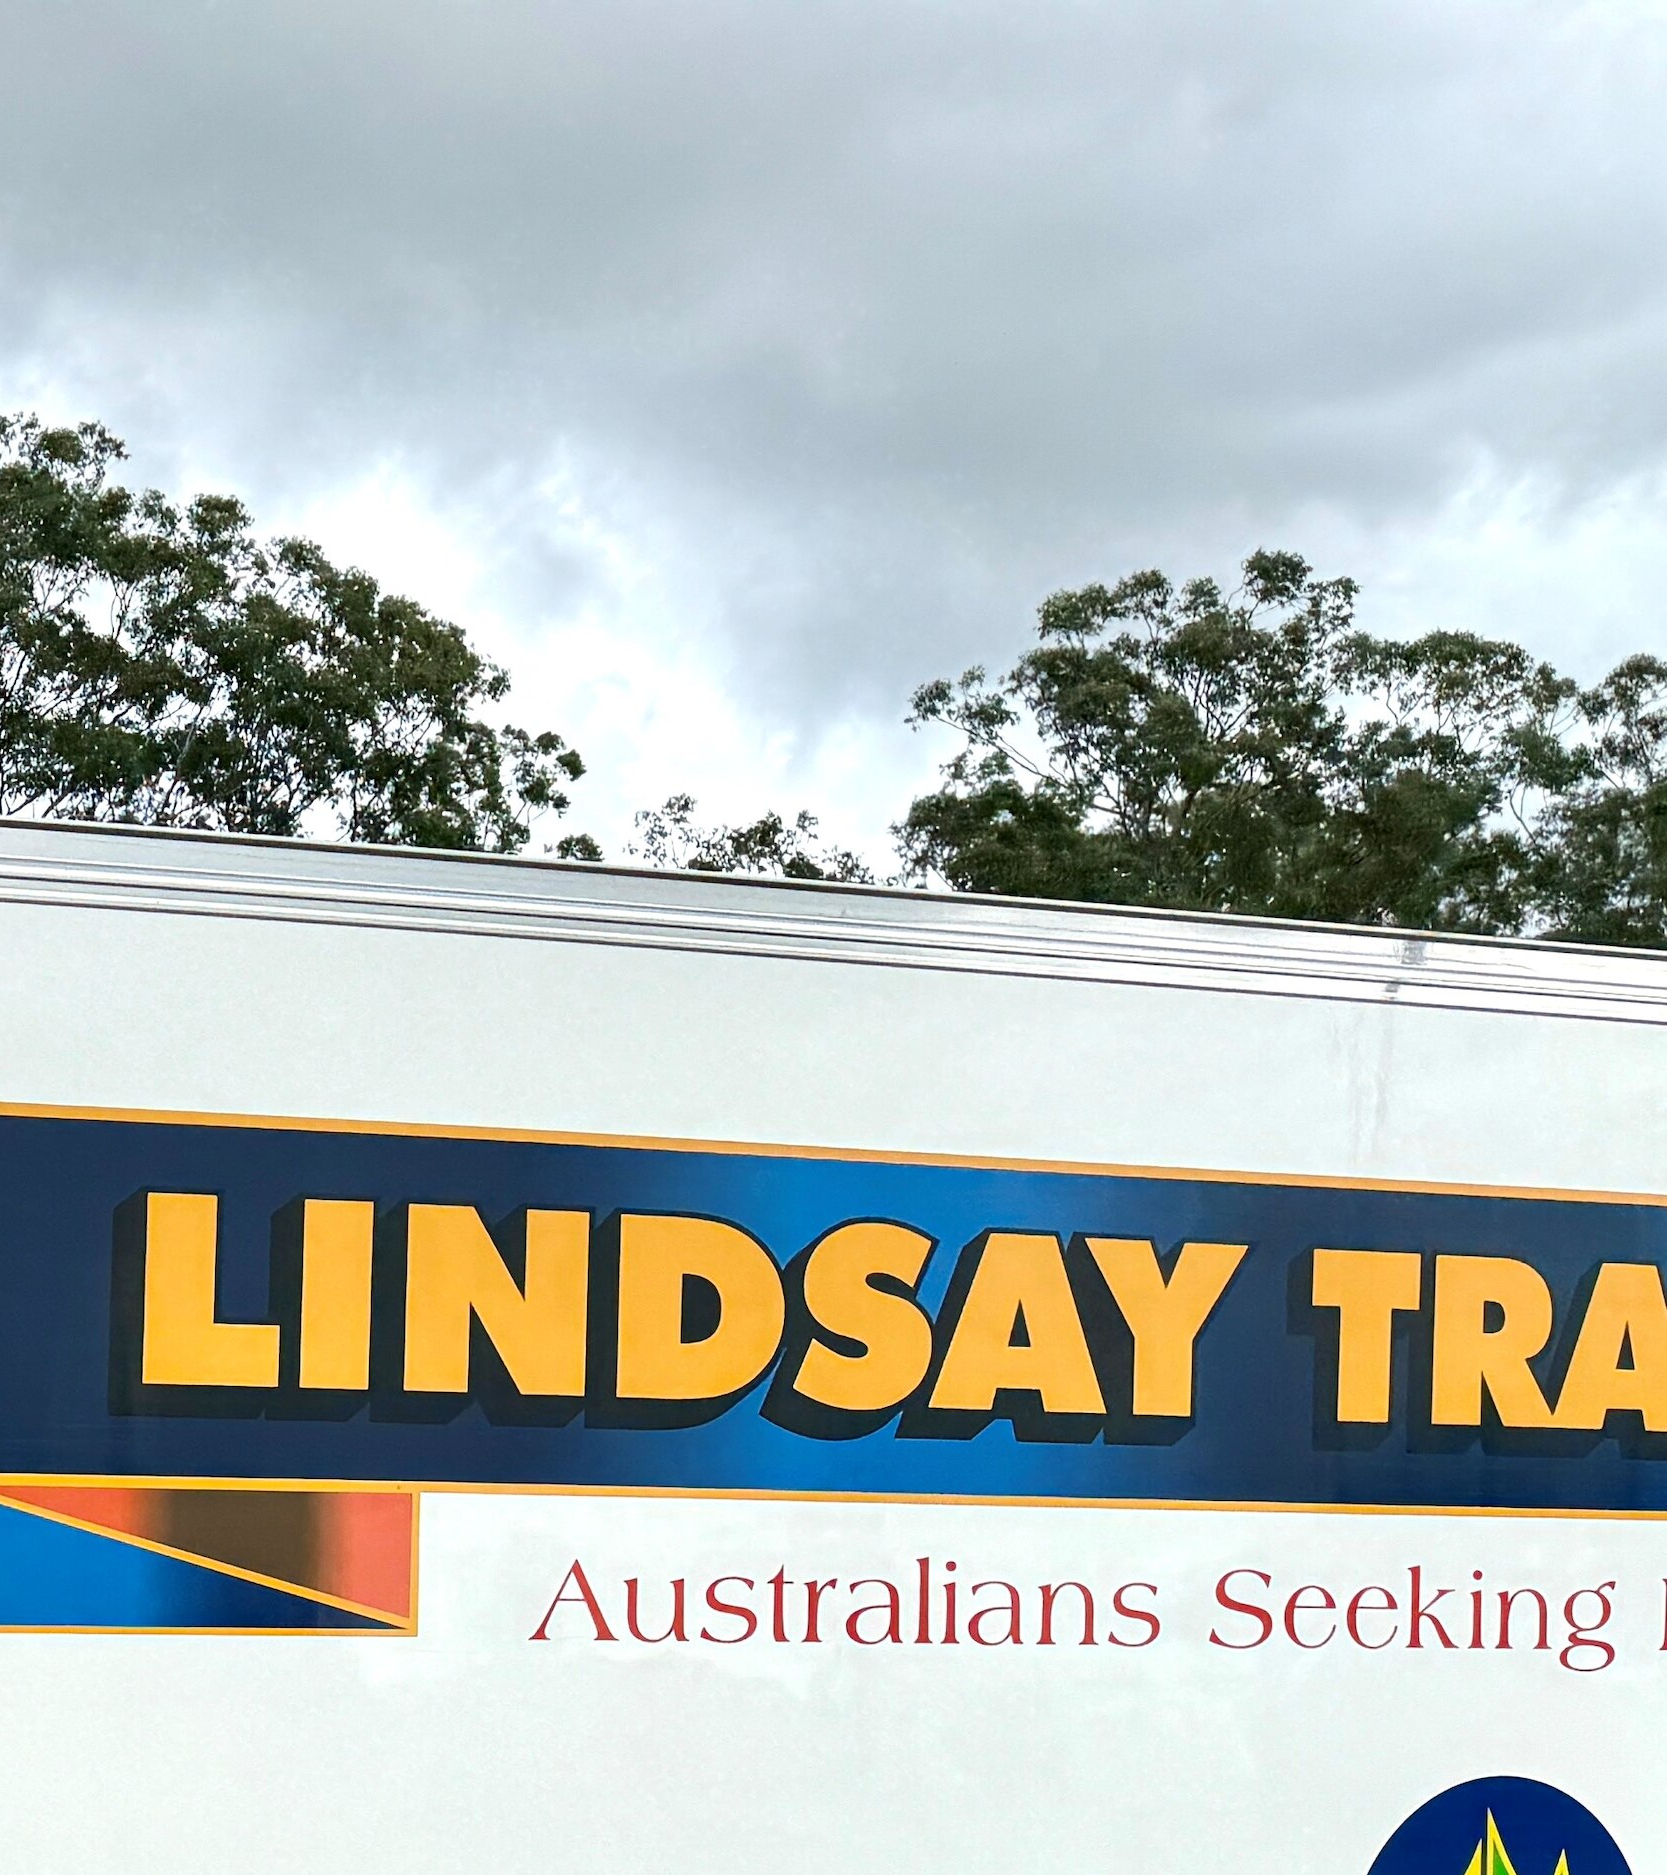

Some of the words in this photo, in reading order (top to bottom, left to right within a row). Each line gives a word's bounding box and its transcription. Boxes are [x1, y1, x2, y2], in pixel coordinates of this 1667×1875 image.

[141, 1190, 1249, 1417] LINDSAY
[1311, 1249, 1667, 1434] TRA
[528, 1556, 1161, 1651] Australians
[1208, 1565, 1616, 1673] Seeking
